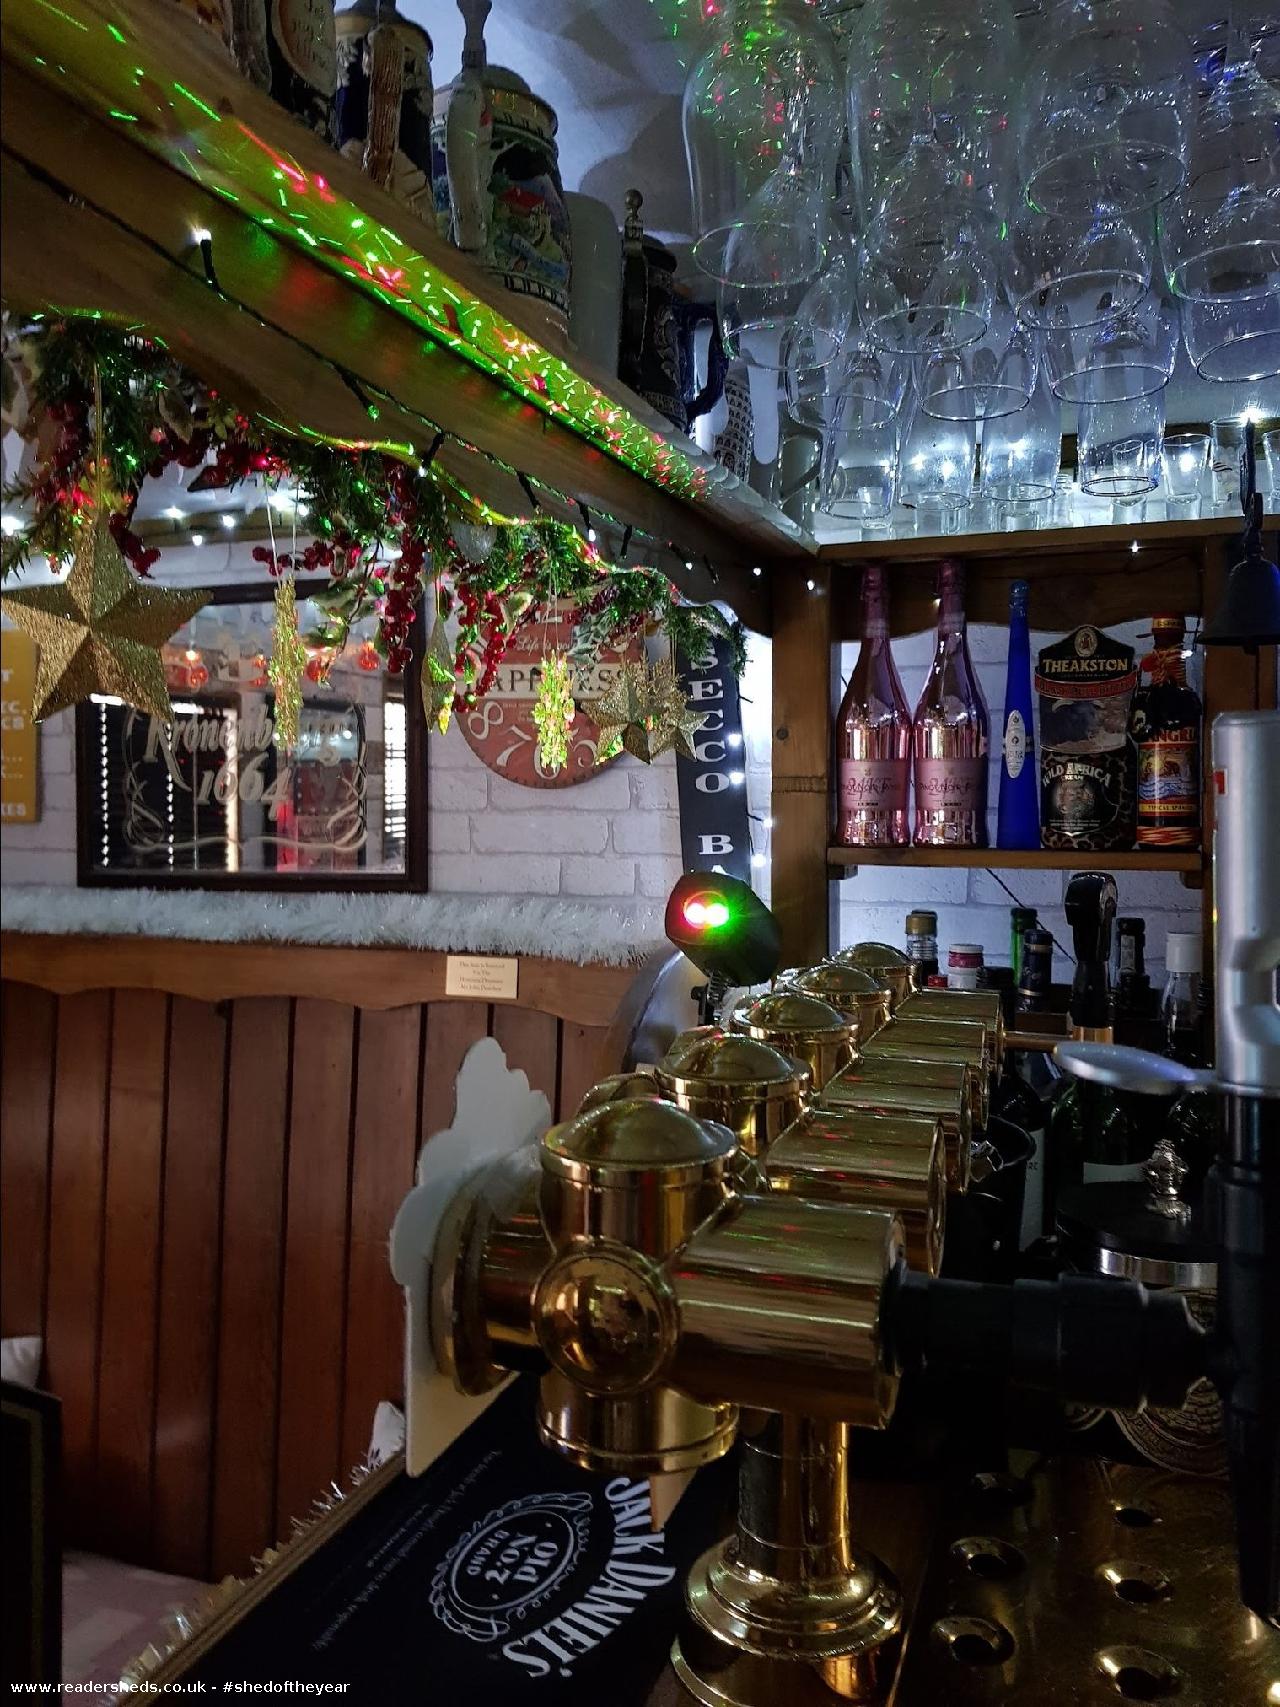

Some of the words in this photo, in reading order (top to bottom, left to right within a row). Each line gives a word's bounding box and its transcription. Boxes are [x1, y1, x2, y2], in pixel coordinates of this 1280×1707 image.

[1042, 657, 1129, 674] THEAKSTON
[197, 753, 292, 821] 1664
[1042, 764, 1065, 788] WILD
[1066, 761, 1112, 788] AFRICA
[604, 1476, 666, 1556] JACK
[502, 1559, 677, 1678] DANIEL'S
